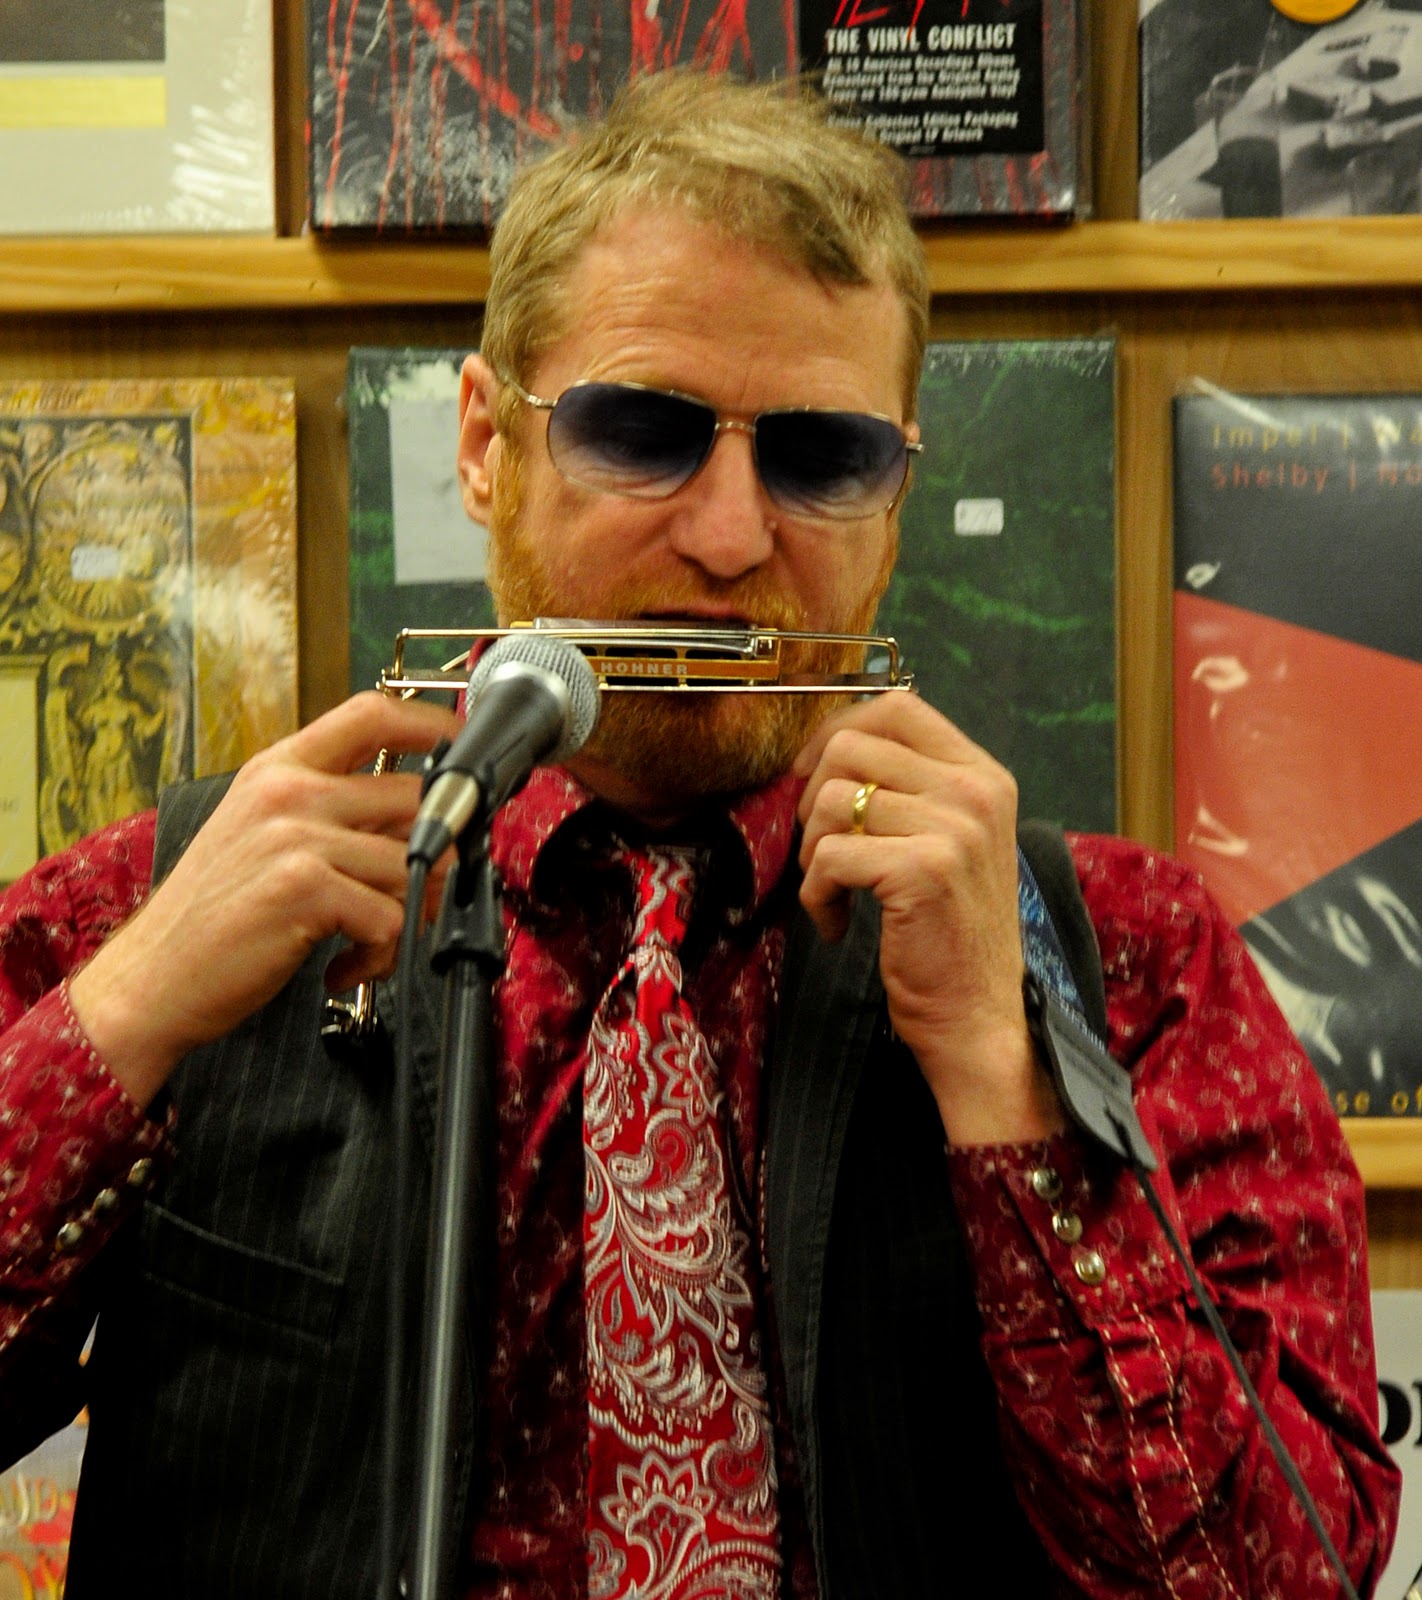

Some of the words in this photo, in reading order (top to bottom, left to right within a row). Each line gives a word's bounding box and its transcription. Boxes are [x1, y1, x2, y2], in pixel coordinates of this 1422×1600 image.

[825, 27, 860, 54] THE
[867, 26, 921, 51] VINYL
[927, 23, 1017, 50] CONFLICT
[1211, 461, 1329, 494] Shelby
[601, 662, 687, 675] HOHNER
